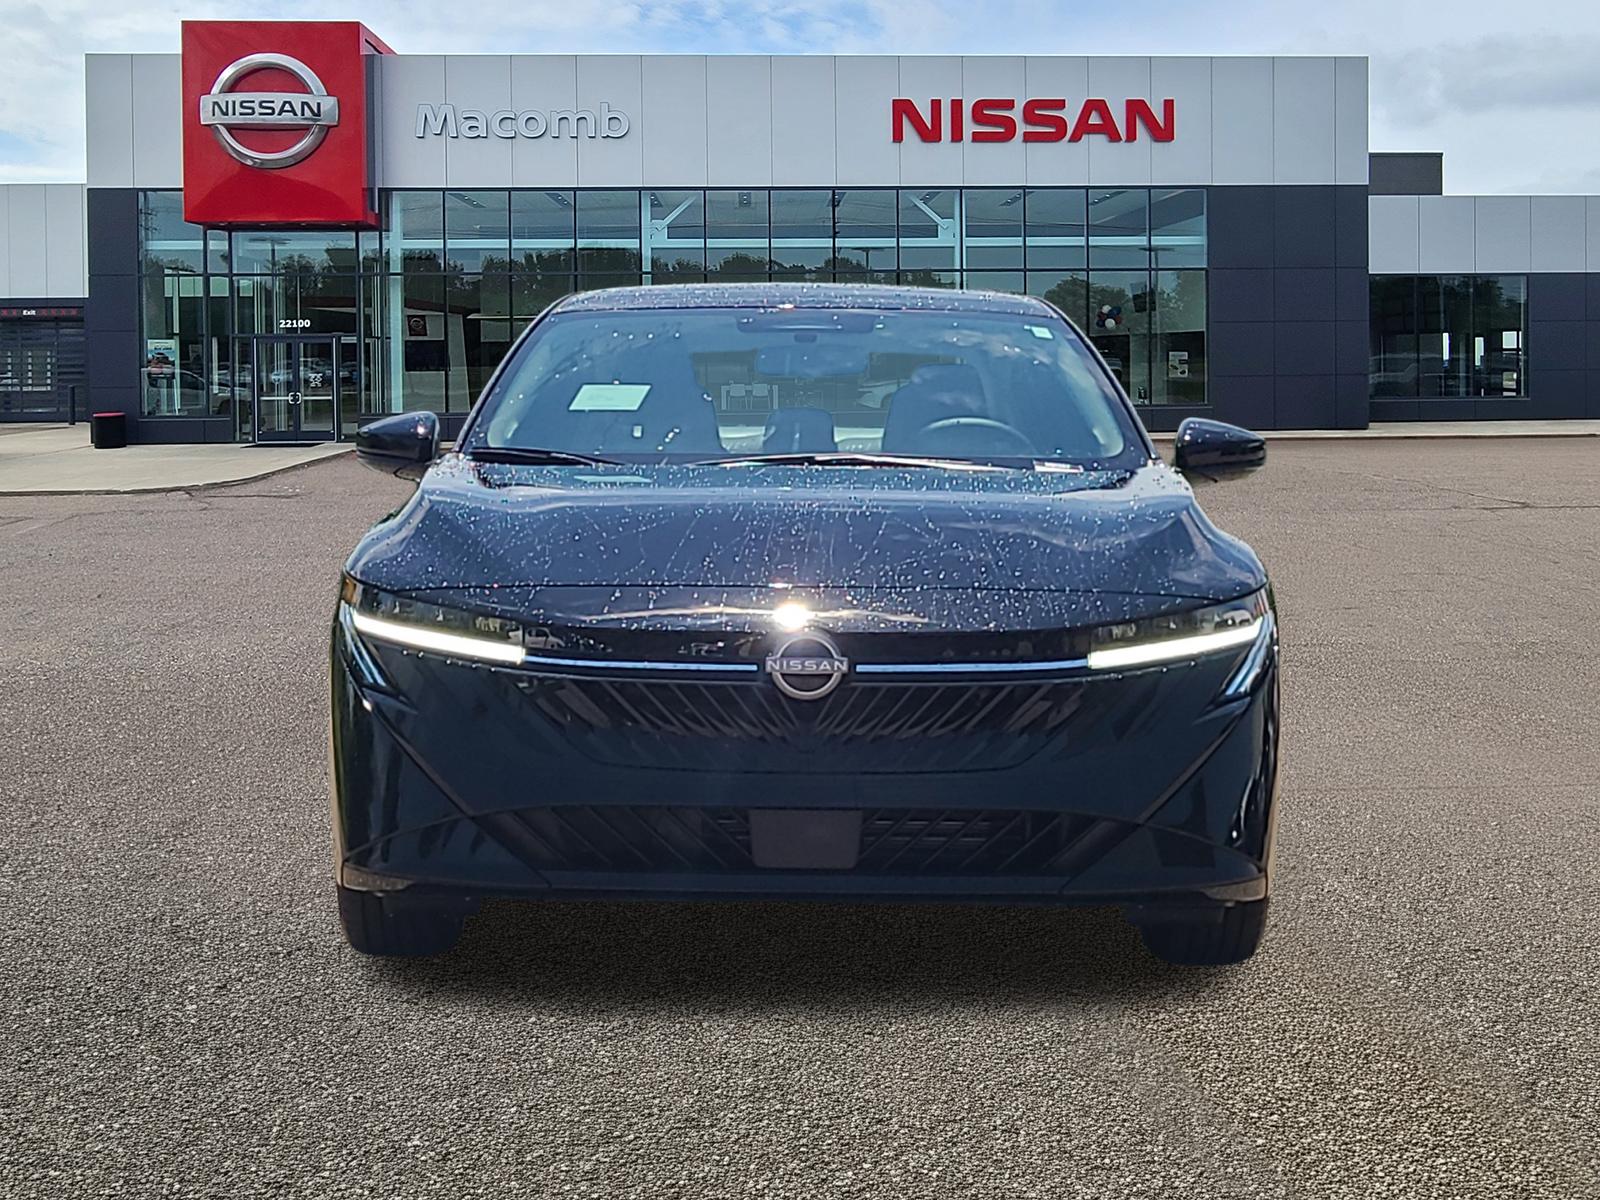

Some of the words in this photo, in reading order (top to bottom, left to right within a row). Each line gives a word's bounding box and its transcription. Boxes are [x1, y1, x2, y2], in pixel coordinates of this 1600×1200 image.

[211, 100, 322, 117] NISSAN
[415, 102, 630, 138] Macomb
[892, 98, 1175, 142] NISSAN
[279, 319, 311, 328] 22100
[766, 660, 847, 672] NISSAN
